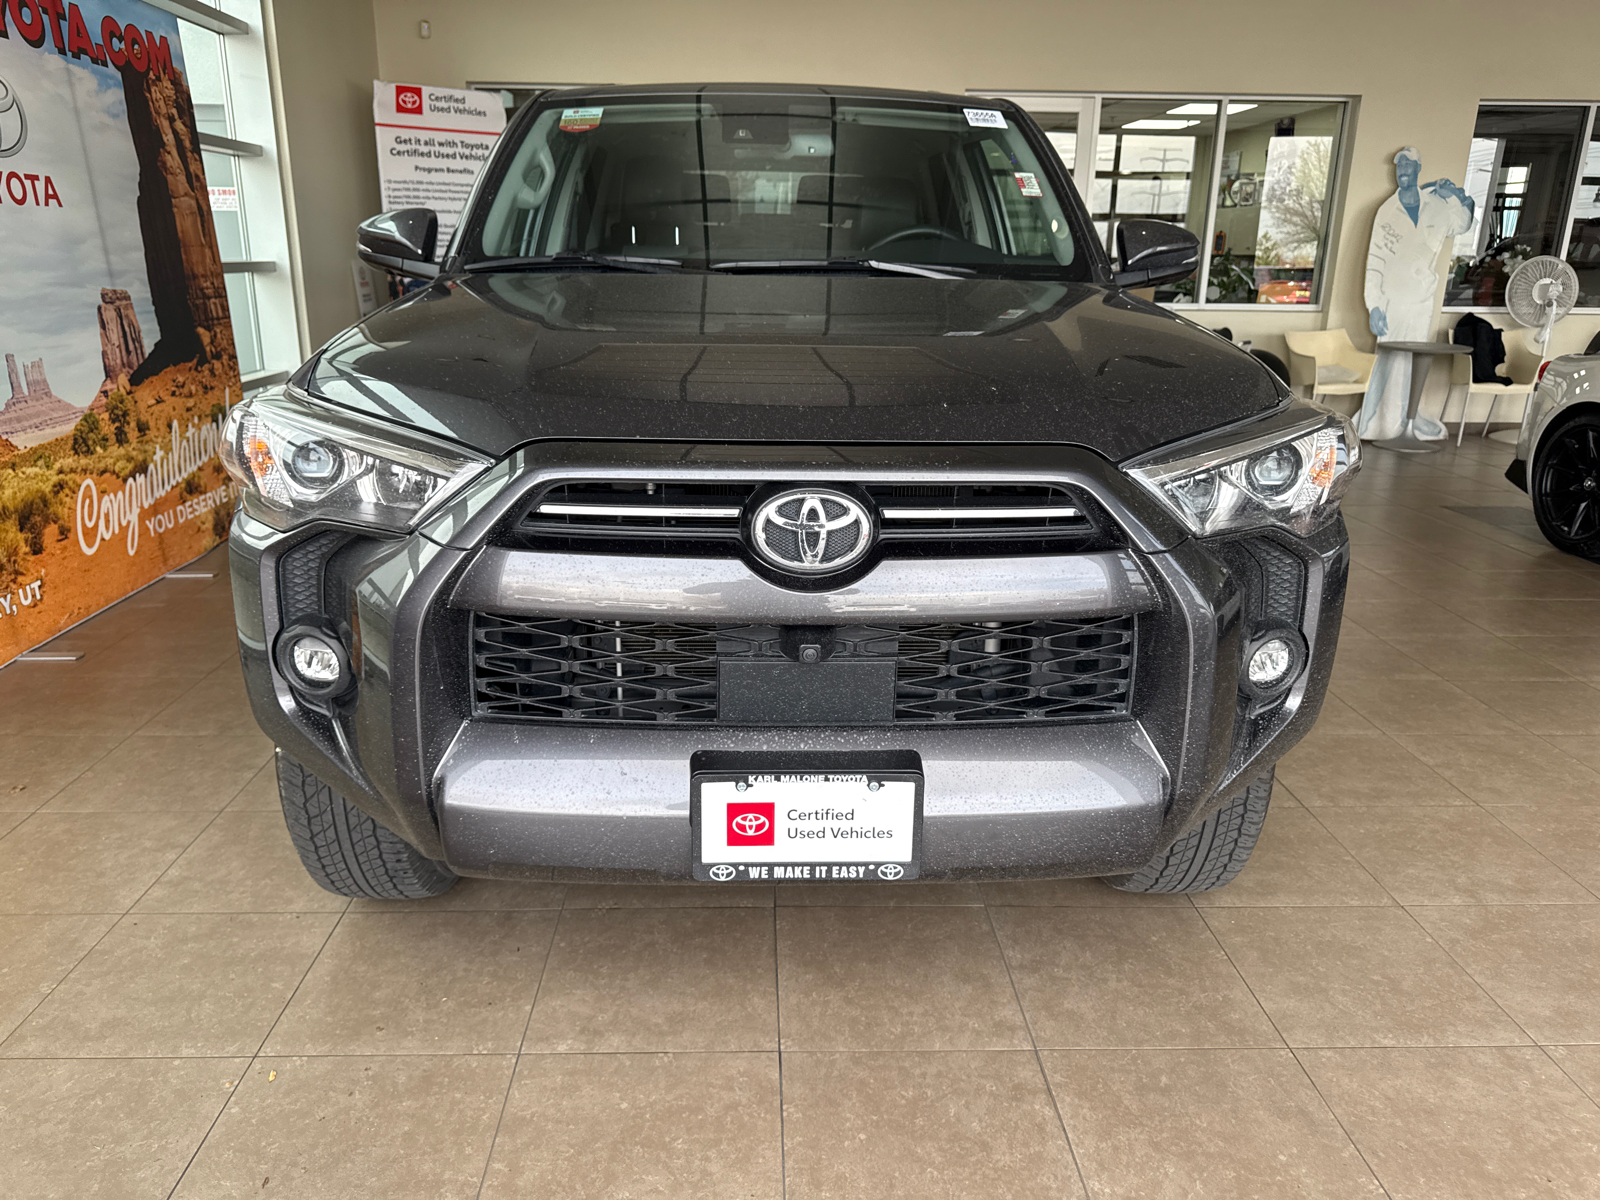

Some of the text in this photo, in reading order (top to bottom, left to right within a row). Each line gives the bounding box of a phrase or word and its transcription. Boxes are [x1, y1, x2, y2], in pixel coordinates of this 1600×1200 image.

[428, 93, 466, 104] Certified
[429, 104, 487, 117] Used Vehicles
[394, 136, 489, 151] Get it all with Toyota
[389, 147, 489, 161] Certified Used Vehicl
[414, 165, 474, 175] Program Benefits
[0, 171, 63, 208] OTA
[145, 514, 175, 537] YOU
[177, 486, 228, 524] DESERVE
[0, 579, 41, 618] Y, UT
[748, 774, 869, 783] KARL MALONE TOYOTA
[787, 808, 855, 821] Certified
[787, 826, 893, 839] Used Vehicles
[749, 865, 866, 879] WE MAKE IT EASY
